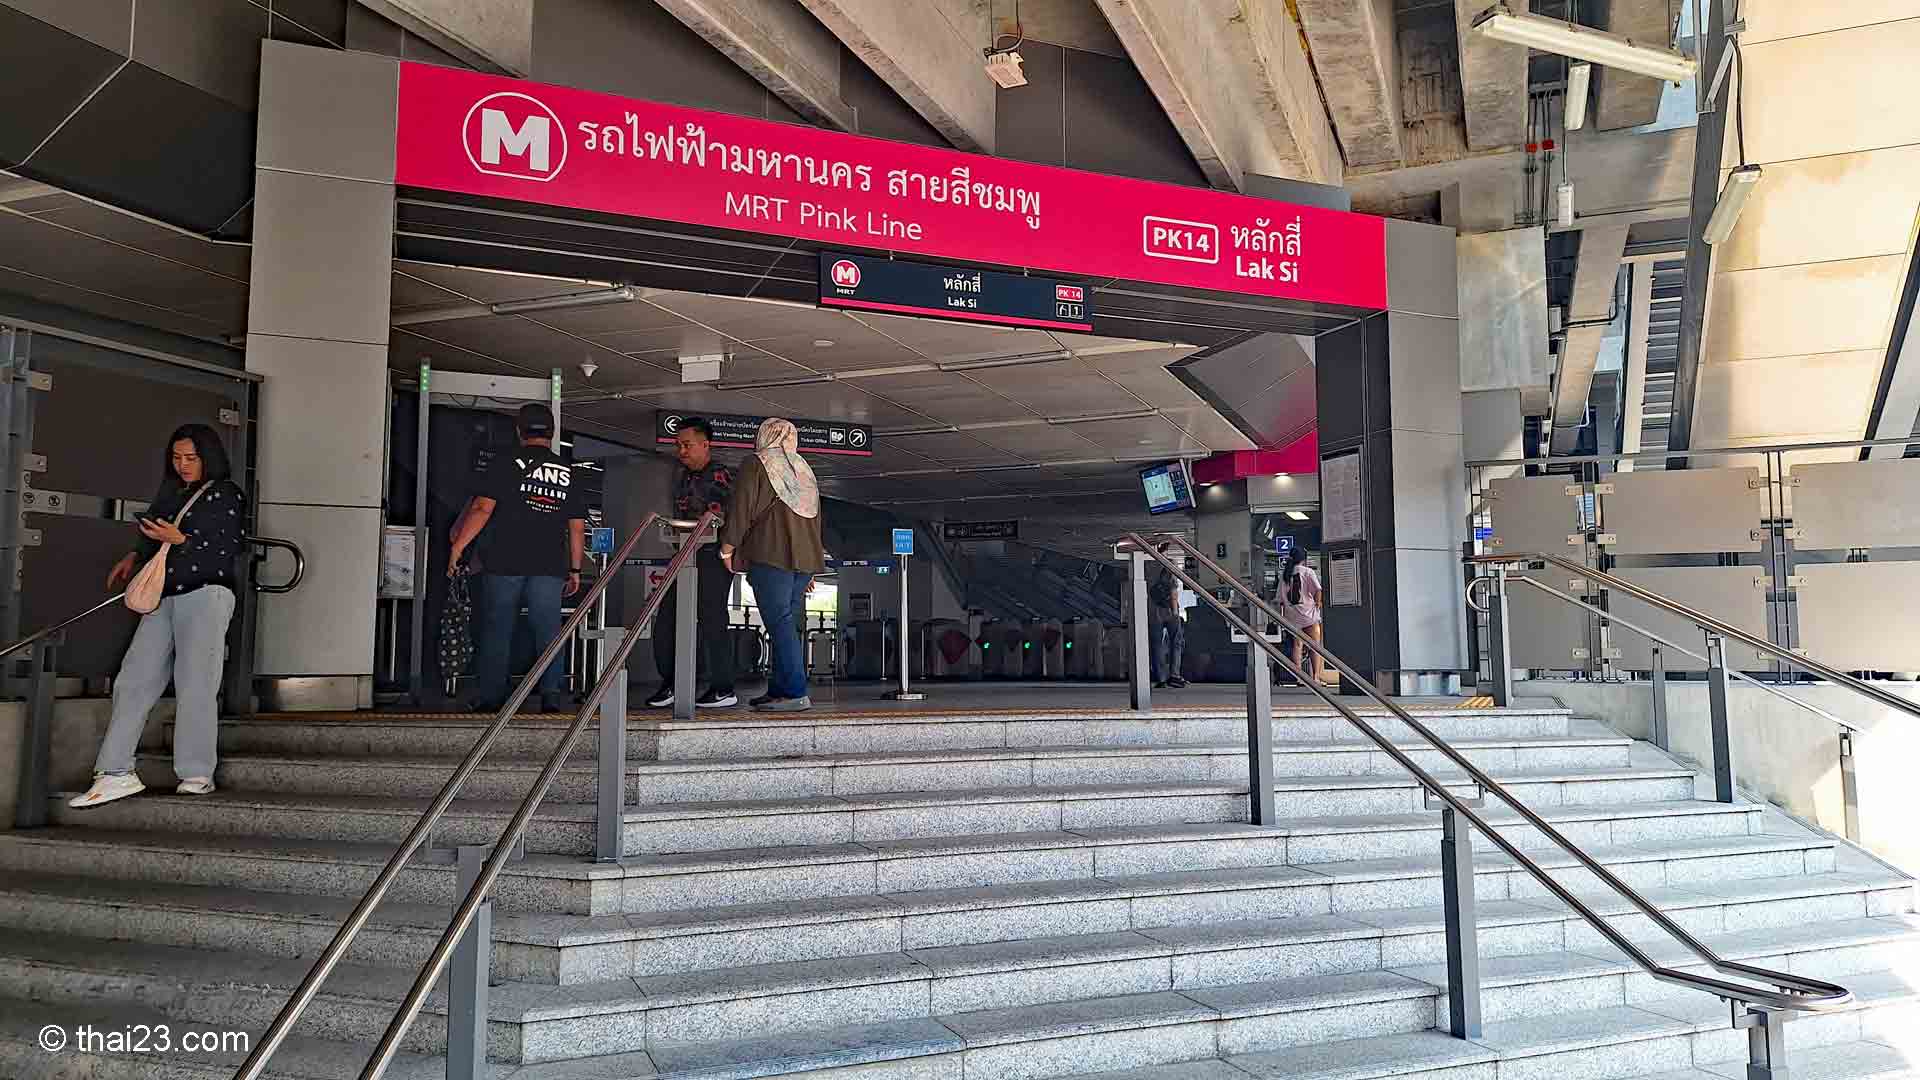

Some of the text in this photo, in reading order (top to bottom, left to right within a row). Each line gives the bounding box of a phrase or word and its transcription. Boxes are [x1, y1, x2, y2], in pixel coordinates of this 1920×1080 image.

[481, 108, 550, 172] M
[578, 112, 1040, 229] รถไฟฟ้ามหานคร สายสีชมพู
[726, 192, 922, 240] MRT Pink Line
[1153, 227, 1210, 252] PK14
[1231, 216, 1301, 256] หลักสี่
[1237, 256, 1298, 283] Lak Si
[836, 287, 856, 296] MRT
[943, 273, 981, 293] หลักสี่
[1058, 289, 1081, 299] PK 14
[947, 297, 977, 309] Lak Si
[1280, 538, 1289, 550] 2
